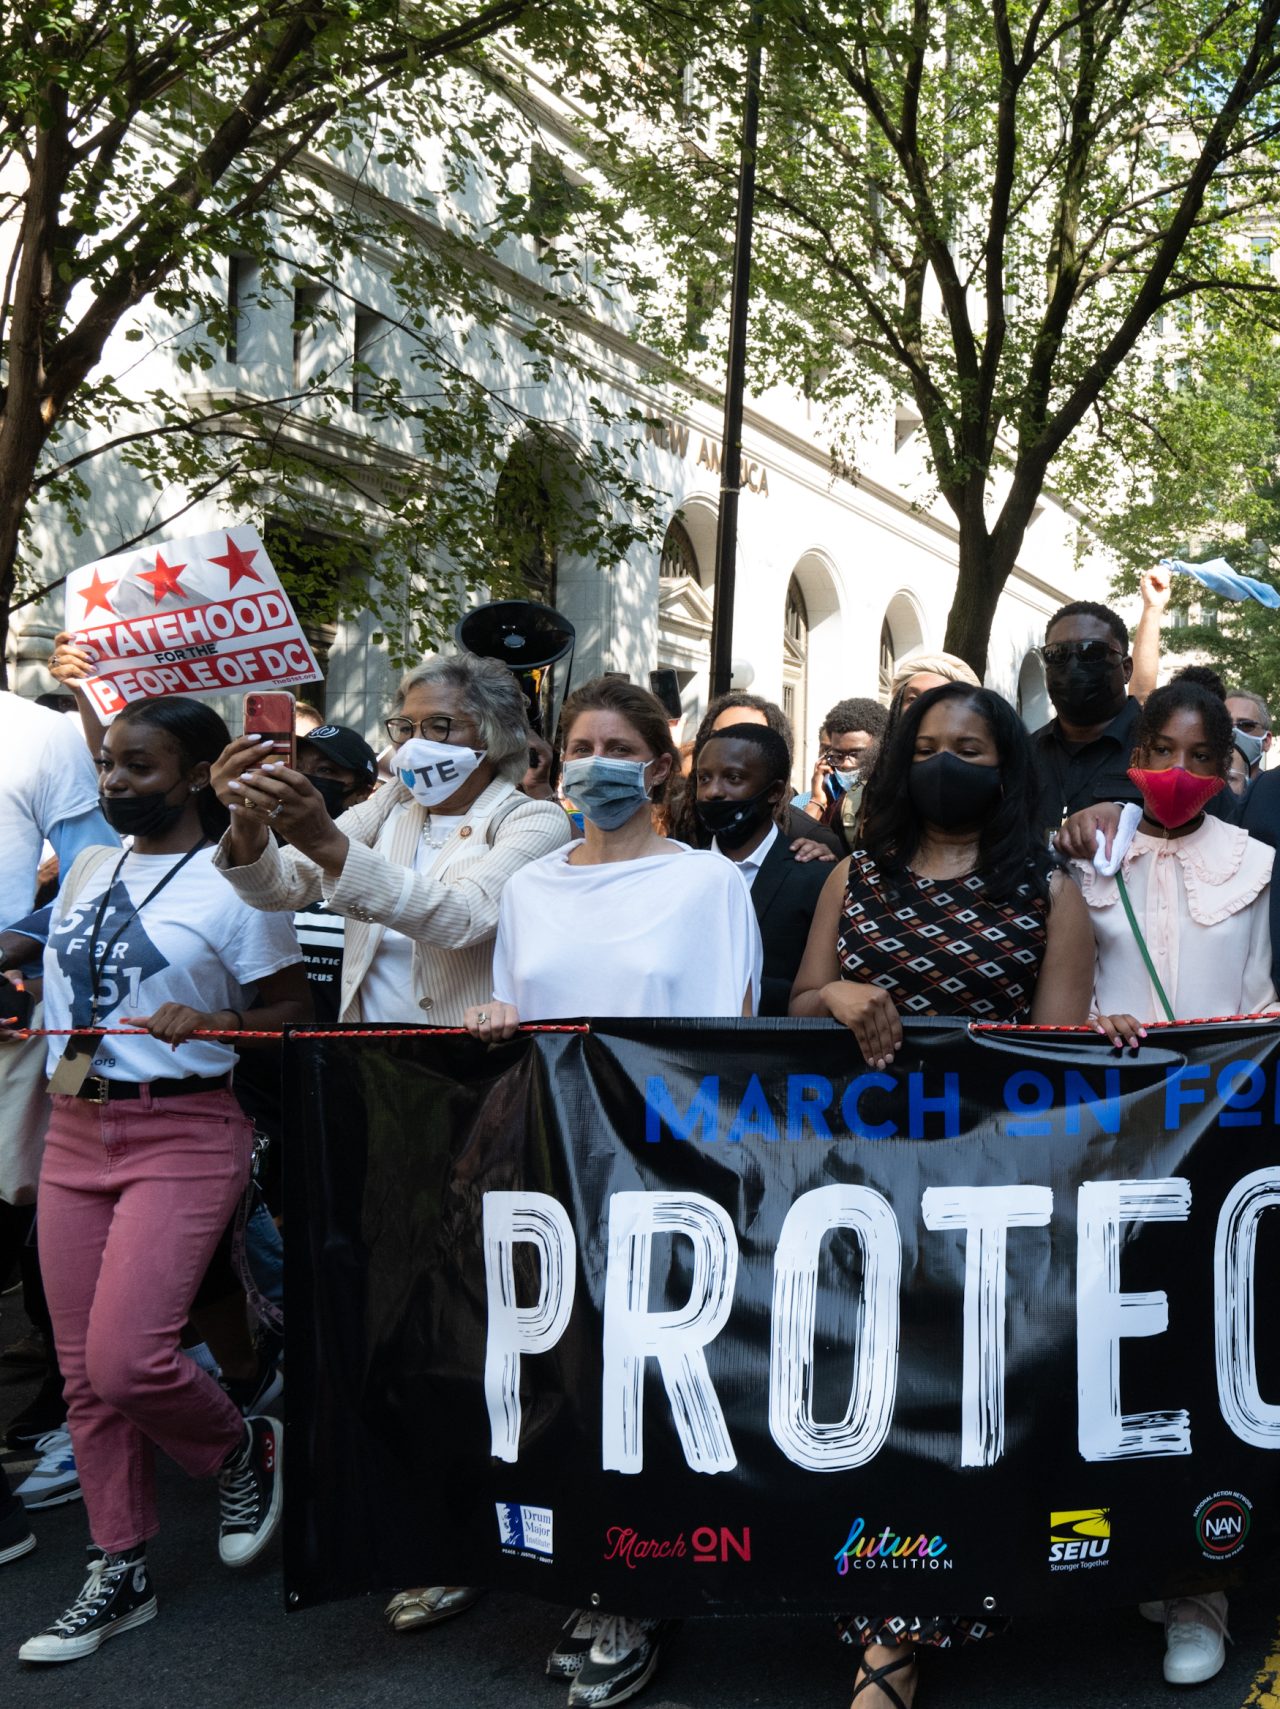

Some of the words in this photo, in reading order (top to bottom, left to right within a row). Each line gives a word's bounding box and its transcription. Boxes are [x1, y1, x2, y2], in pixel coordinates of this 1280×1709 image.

[74, 594, 288, 661] STATEHOOD
[154, 650, 186, 664] FOR
[186, 643, 219, 660] THE
[90, 661, 222, 711] PEOPLE
[217, 652, 260, 684] OF
[260, 643, 310, 677] DC
[66, 938, 130, 959] FOR
[89, 964, 143, 1009] 51
[645, 1071, 960, 1143] MARCH
[1003, 1067, 1121, 1137] ON
[523, 1508, 551, 1524] Drum
[1193, 1495, 1213, 1518] NATIONAL
[1213, 1490, 1232, 1498] ACTION
[1233, 1492, 1253, 1510] NETWORK
[525, 1520, 551, 1537] Major
[1206, 1516, 1242, 1538] NAN
[603, 1526, 687, 1569] March
[691, 1526, 751, 1562] ON
[833, 1517, 948, 1576] future
[1048, 1538, 1111, 1562] SEIU
[853, 1558, 953, 1570] COALITION
[1050, 1563, 1080, 1572] Stronger
[1080, 1559, 1110, 1570] Together
